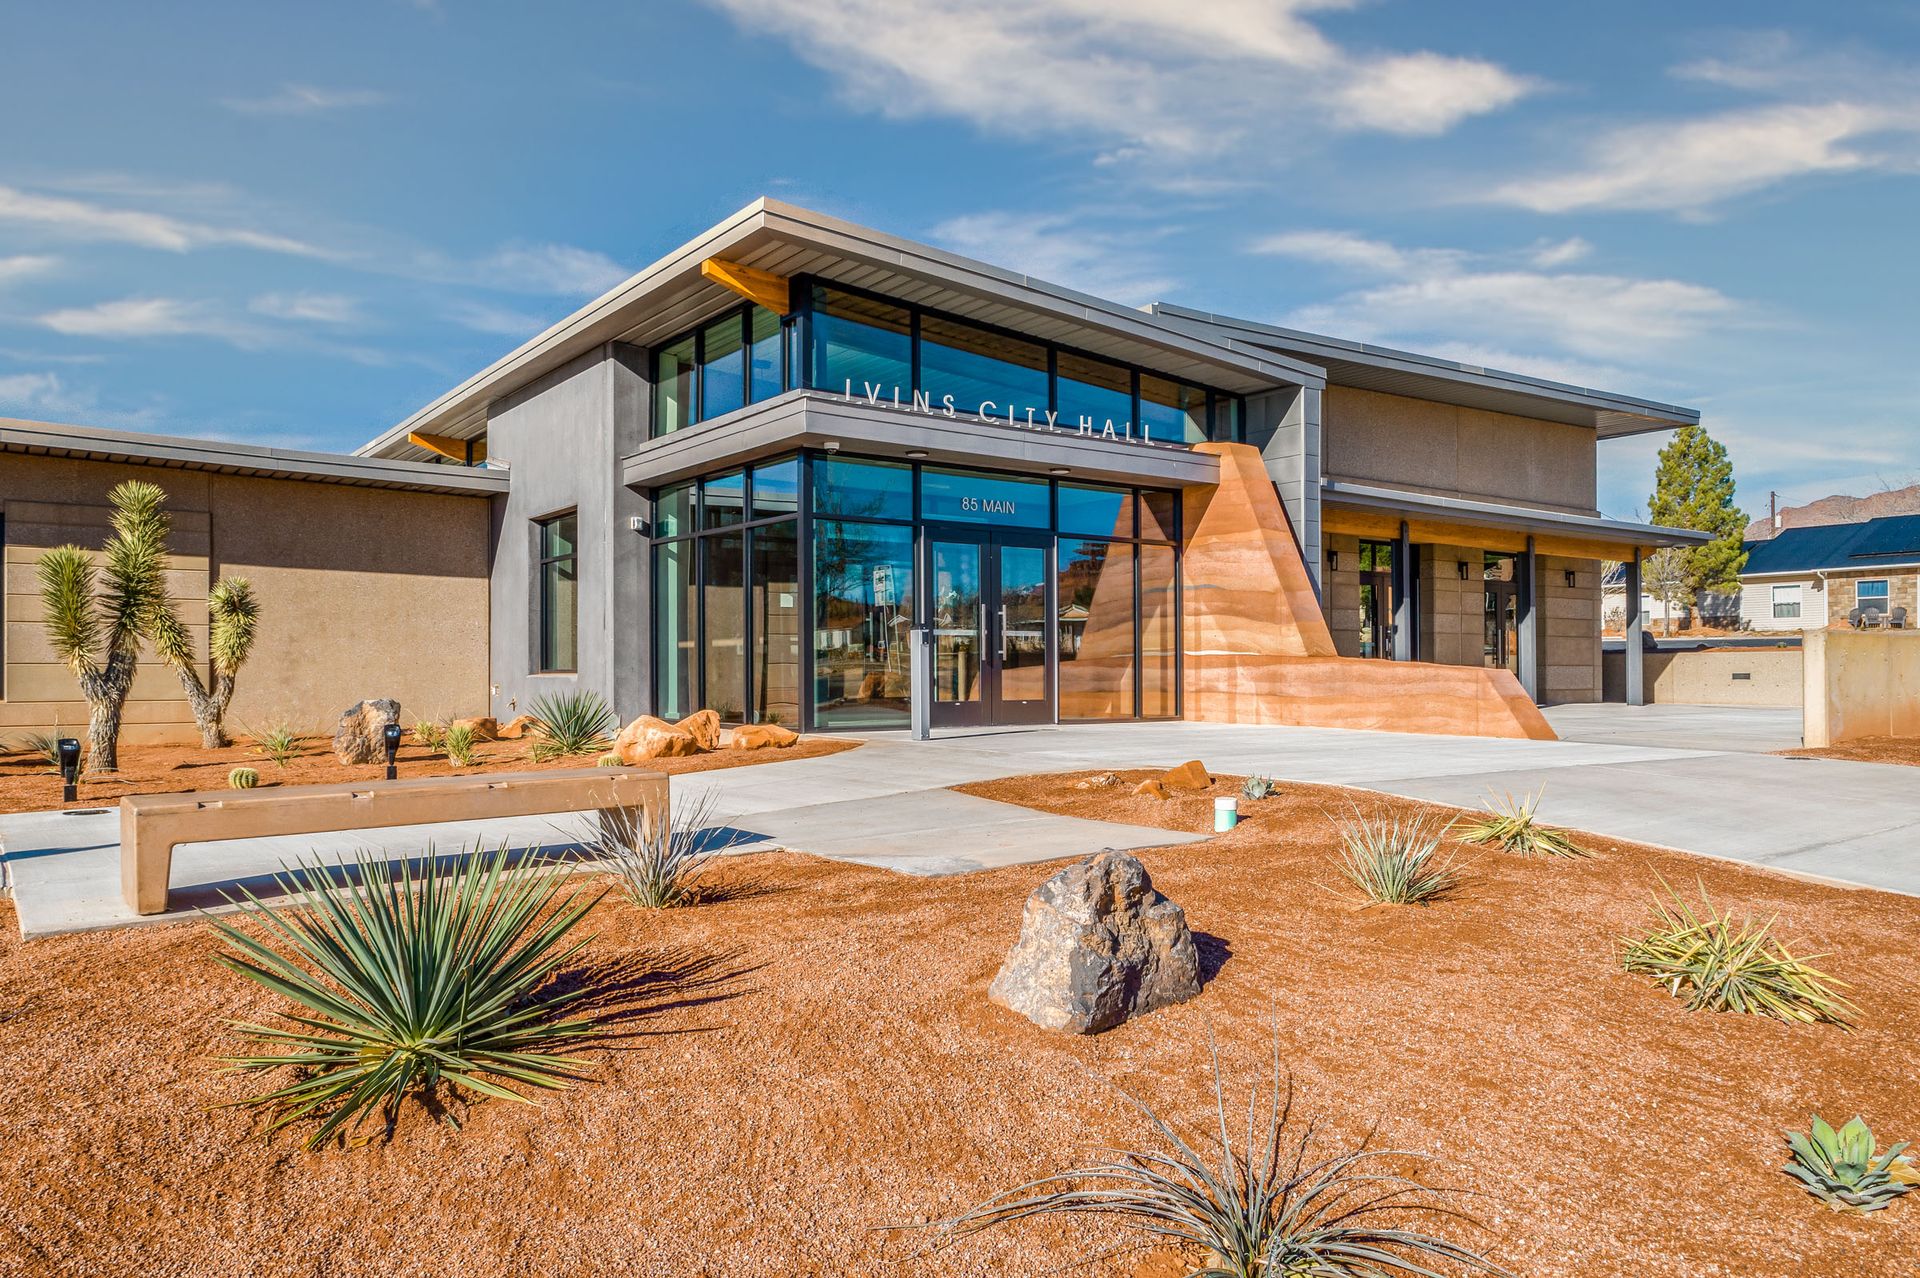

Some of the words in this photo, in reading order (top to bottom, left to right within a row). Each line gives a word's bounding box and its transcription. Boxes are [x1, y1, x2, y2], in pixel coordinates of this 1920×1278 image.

[845, 378, 955, 417] IVINS
[979, 401, 1058, 431] CITY
[1079, 415, 1155, 446] HALL
[962, 496, 978, 511] 85
[983, 499, 1015, 514] MAIN
